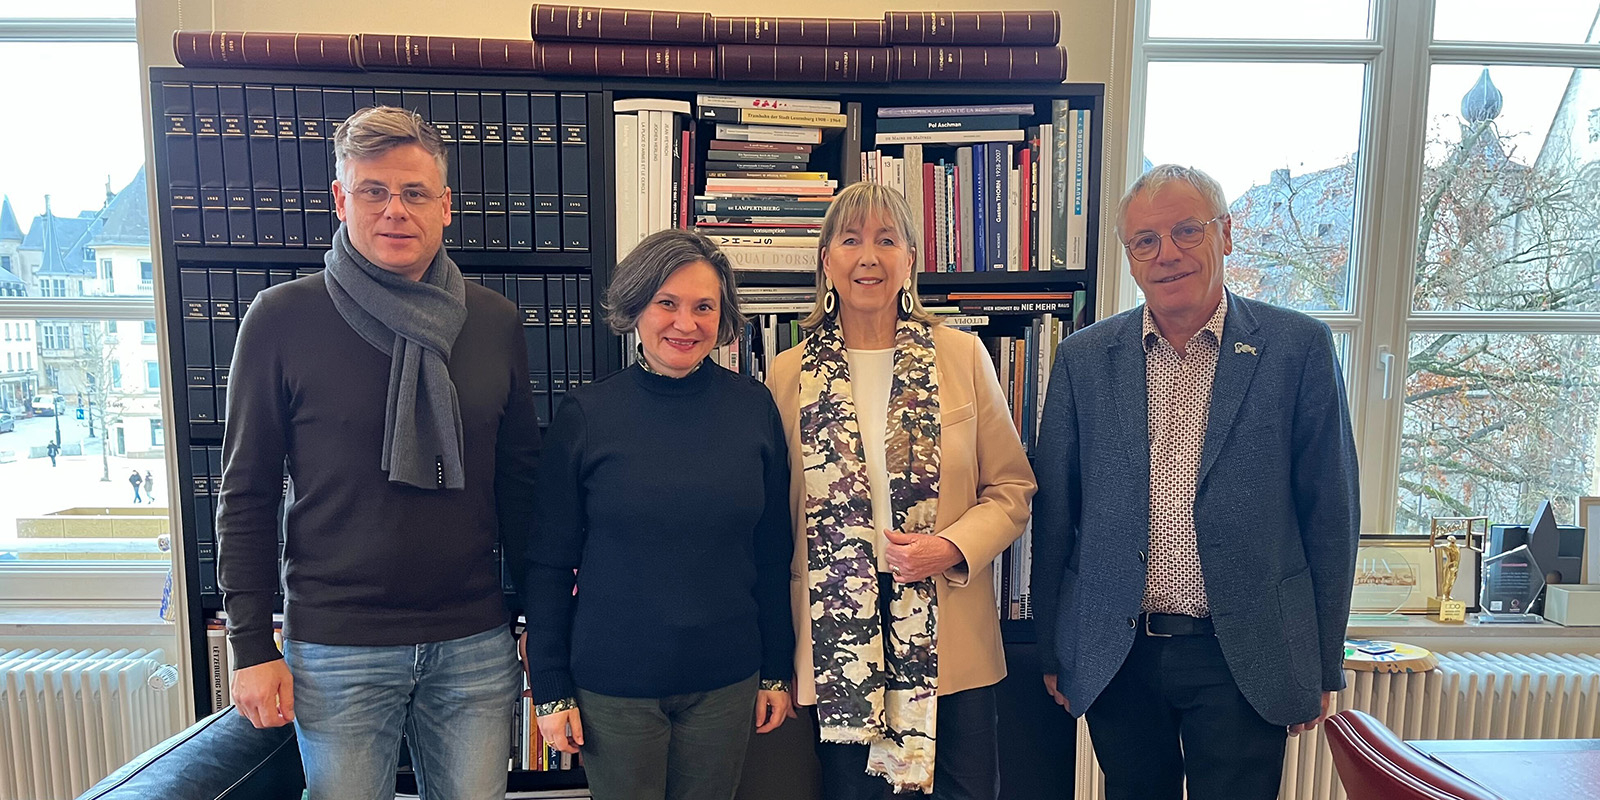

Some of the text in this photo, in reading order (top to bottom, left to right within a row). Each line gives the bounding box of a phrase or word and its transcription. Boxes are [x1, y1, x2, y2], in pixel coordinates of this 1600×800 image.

[721, 237, 773, 245] VHILS
[735, 252, 816, 266] QUAI D'ORSA
[1021, 303, 1034, 311] NIE
[1035, 303, 1057, 311] MEHR
